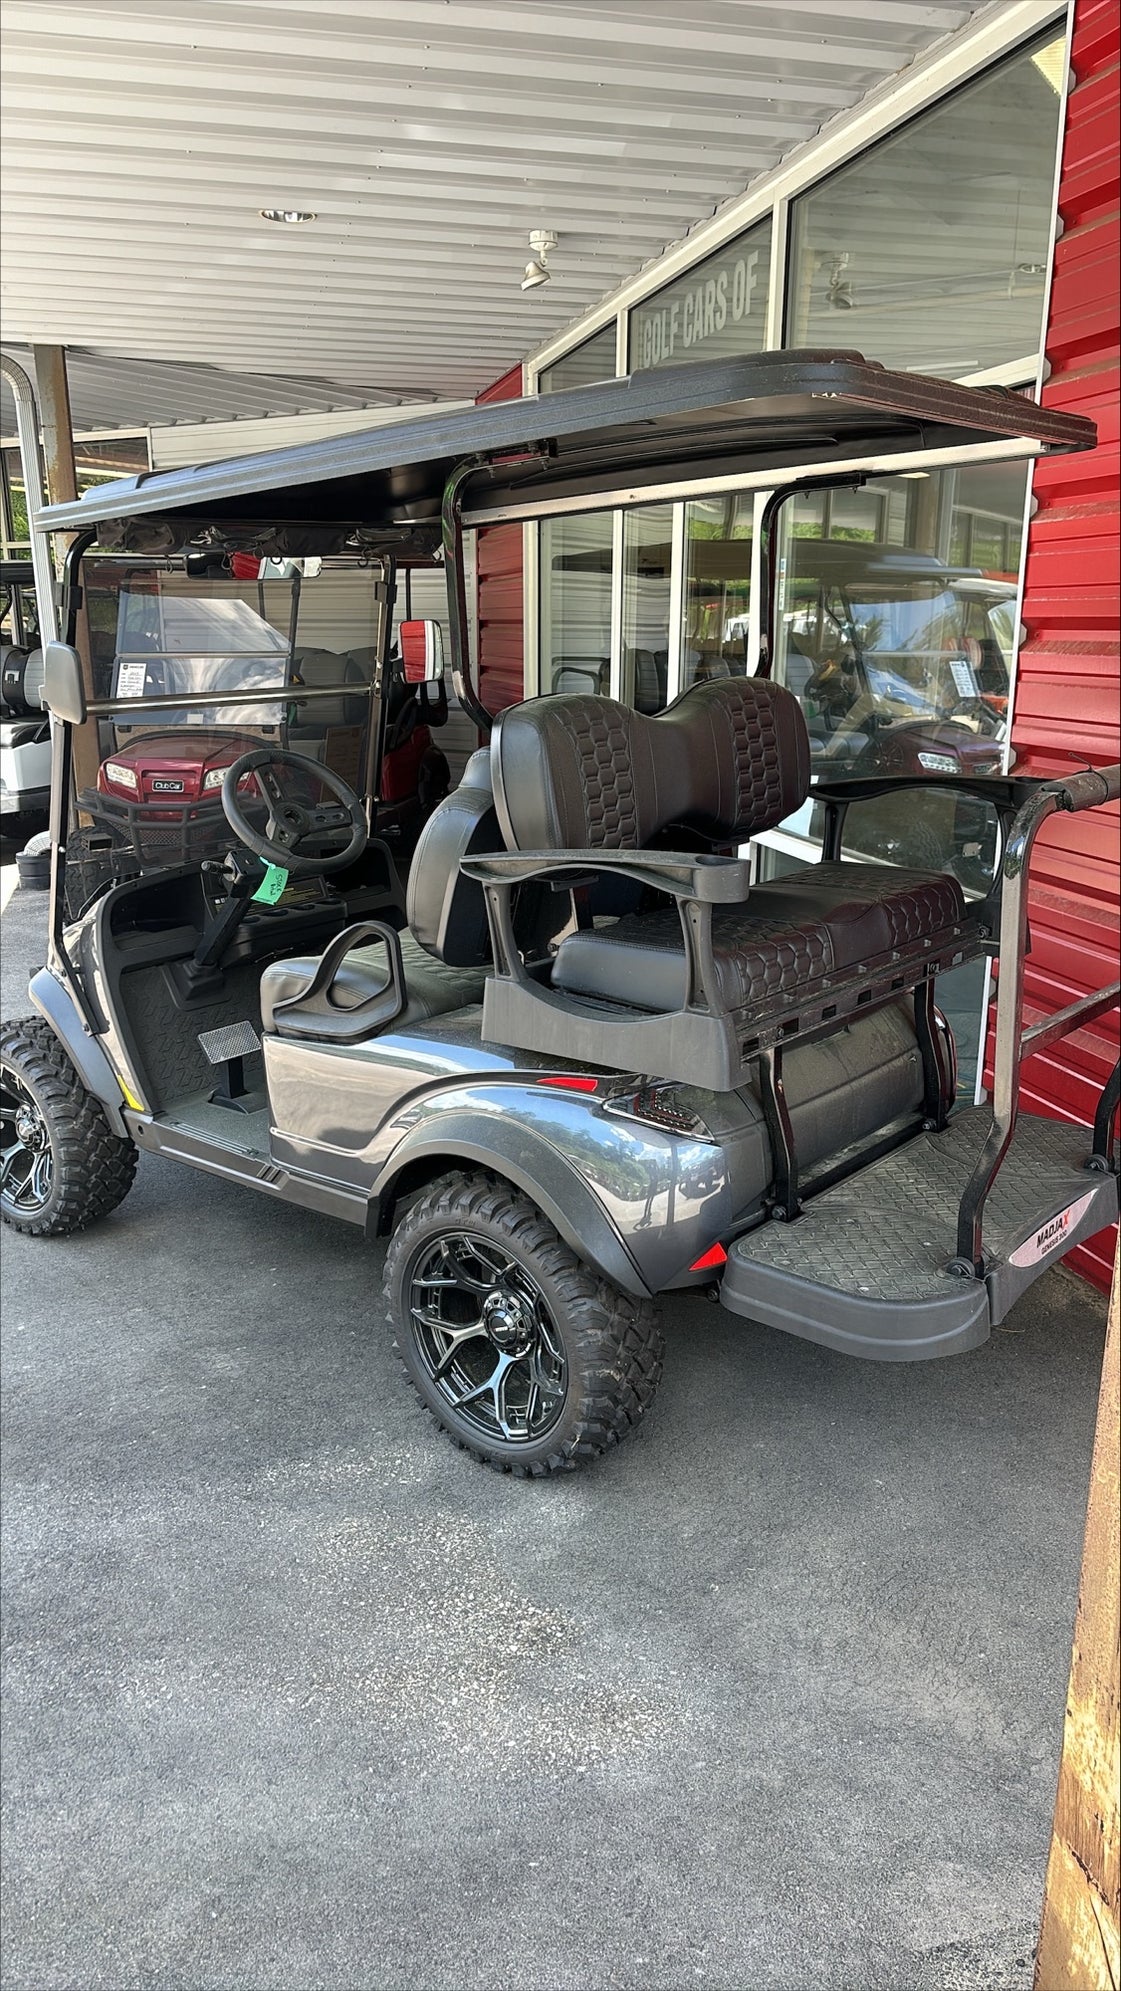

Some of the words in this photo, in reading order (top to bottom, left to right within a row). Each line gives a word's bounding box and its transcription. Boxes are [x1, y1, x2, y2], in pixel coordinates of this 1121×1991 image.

[643, 303, 679, 368] GOLF
[683, 270, 728, 348] CARS
[732, 250, 759, 321] OF
[155, 782, 170, 790] Club
[170, 782, 182, 790] Car
[1036, 1209, 1070, 1248] MADJAX
